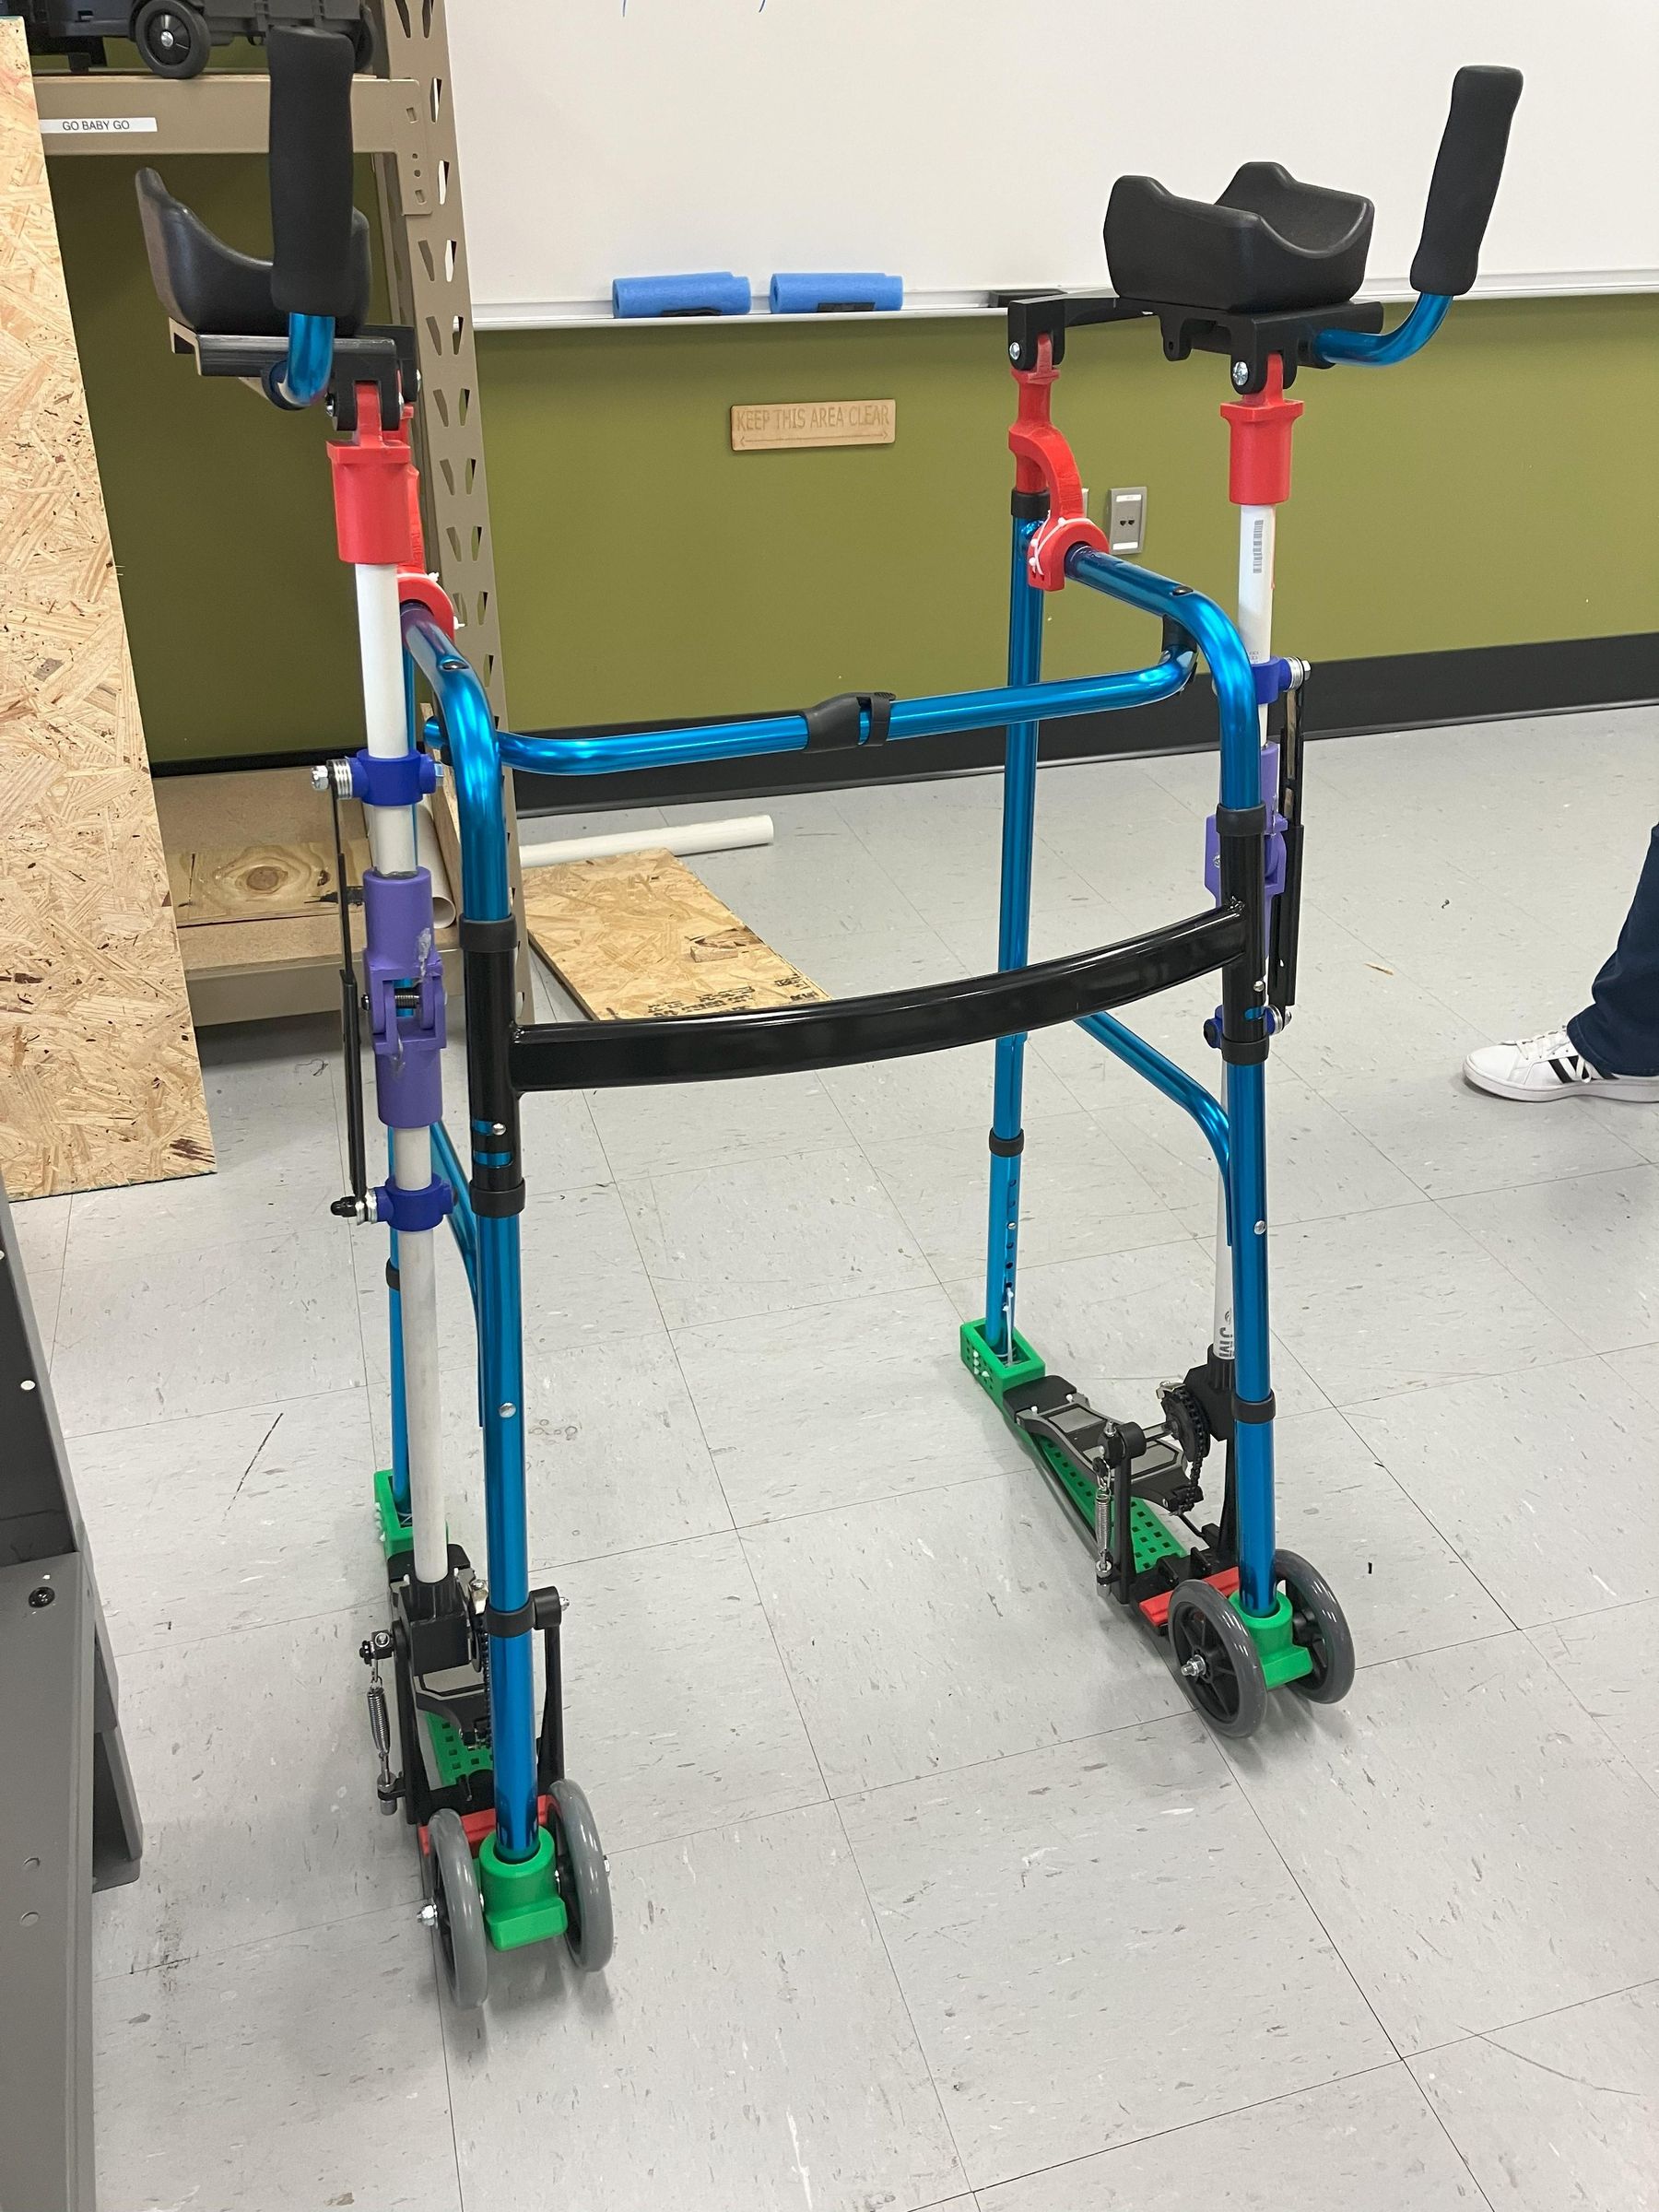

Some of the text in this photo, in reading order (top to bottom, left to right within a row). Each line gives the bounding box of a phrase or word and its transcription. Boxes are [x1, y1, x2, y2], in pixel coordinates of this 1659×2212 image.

[62, 120, 130, 131] GO BABY GO
[736, 405, 889, 431] KEEP THIS AREA CLEAR
